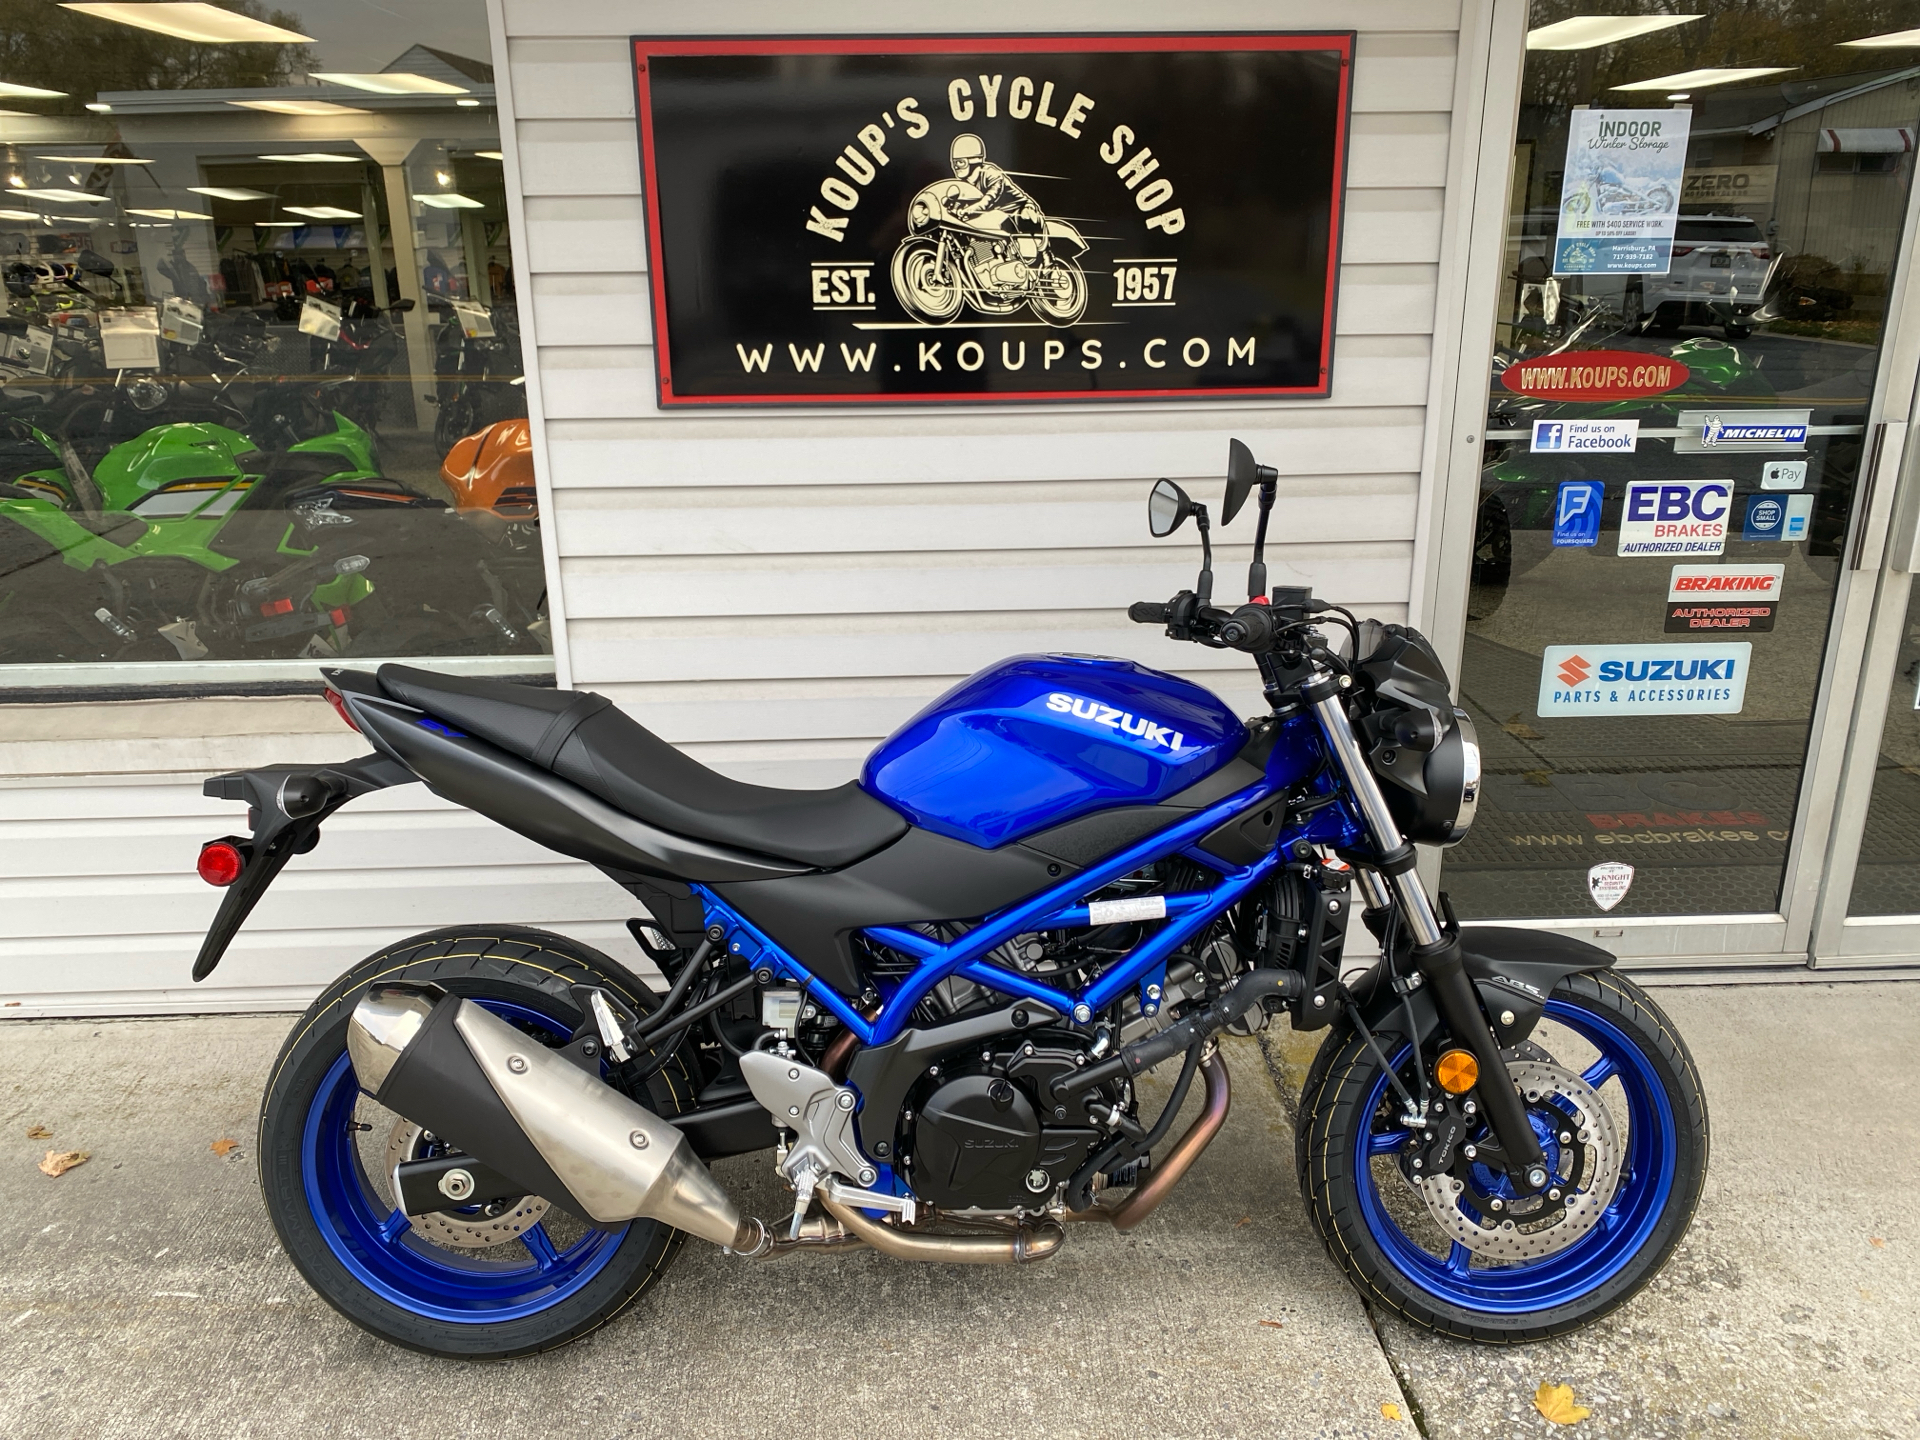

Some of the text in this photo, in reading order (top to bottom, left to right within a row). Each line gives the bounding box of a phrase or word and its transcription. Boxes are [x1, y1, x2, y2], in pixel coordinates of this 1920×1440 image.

[1598, 113, 1662, 137] INDOOR
[1587, 136, 1670, 154] Winter Storage
[806, 74, 1187, 243] KOUP'S CYCLE SHOP
[1686, 174, 1750, 190] ZERO
[1576, 220, 1590, 228] FREE
[1591, 220, 1605, 228] WITH
[1606, 220, 1622, 229] $400
[1622, 220, 1645, 228] SERVICE
[1612, 245, 1647, 253] Harrisburg,
[812, 269, 876, 304] EST.
[1112, 266, 1176, 301] 1957
[1521, 365, 1672, 390] WWW.KOUPS.COM
[1569, 424, 1615, 433] Find us on
[1723, 428, 1803, 439] MICHELIN
[1568, 434, 1632, 449] Facebook
[1781, 468, 1802, 482] Pay
[1627, 485, 1729, 522] EBC
[1654, 523, 1723, 538] BRAKES
[1622, 542, 1722, 553] AUTHORIZED DEALER
[1673, 576, 1776, 591] BRAKING
[1672, 607, 1771, 618] AUTHORIZED
[1689, 617, 1751, 628] DEALER
[1598, 659, 1736, 682] SUZUKI
[1553, 688, 1731, 704] PARTS & ACCESSORIES
[415, 719, 468, 739] SV
[1046, 692, 1184, 752] SUZUKI
[1585, 811, 1770, 830] BRAKES
[1509, 834, 1583, 846] www
[1594, 828, 1760, 845] ebcbrakes
[1491, 975, 1541, 996] ABS
[964, 1138, 1020, 1149] SUZUKI
[1438, 1126, 1456, 1165] TOKICO
